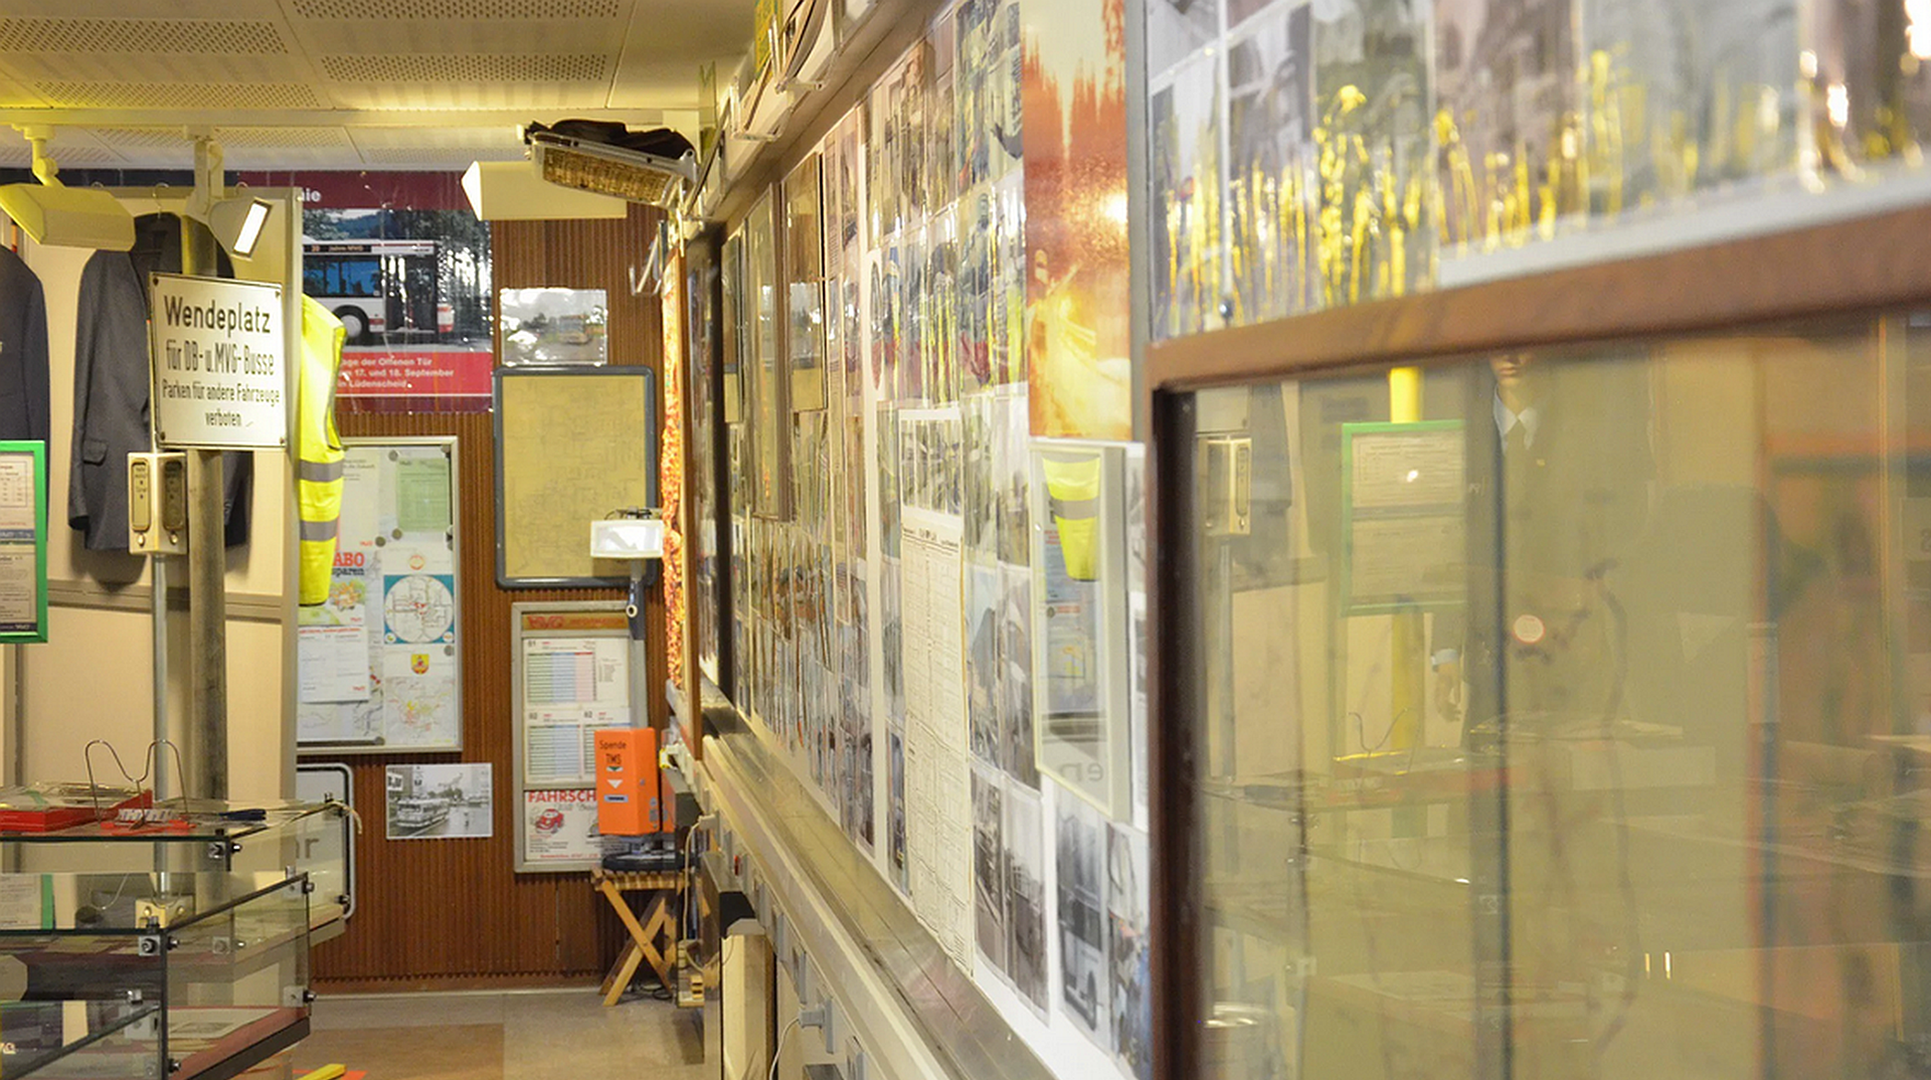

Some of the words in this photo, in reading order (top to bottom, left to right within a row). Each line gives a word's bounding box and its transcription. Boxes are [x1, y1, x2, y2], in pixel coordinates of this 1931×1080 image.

[163, 294, 271, 339] Wendeplatz
[165, 338, 182, 371] für
[361, 357, 377, 366] der
[378, 357, 415, 366] Offenen
[417, 357, 433, 366] Tür
[354, 368, 367, 377] 17.
[369, 368, 387, 377] und
[388, 368, 402, 377] 18.
[404, 368, 454, 379] September
[161, 378, 192, 399] Parken
[192, 380, 206, 400] für
[206, 382, 236, 402] andere
[236, 382, 280, 408] Fahrzeuge
[204, 408, 242, 427] verboten
[333, 552, 365, 568] ABO
[599, 740, 627, 751] Spende
[528, 789, 597, 803] FAHRSCH
